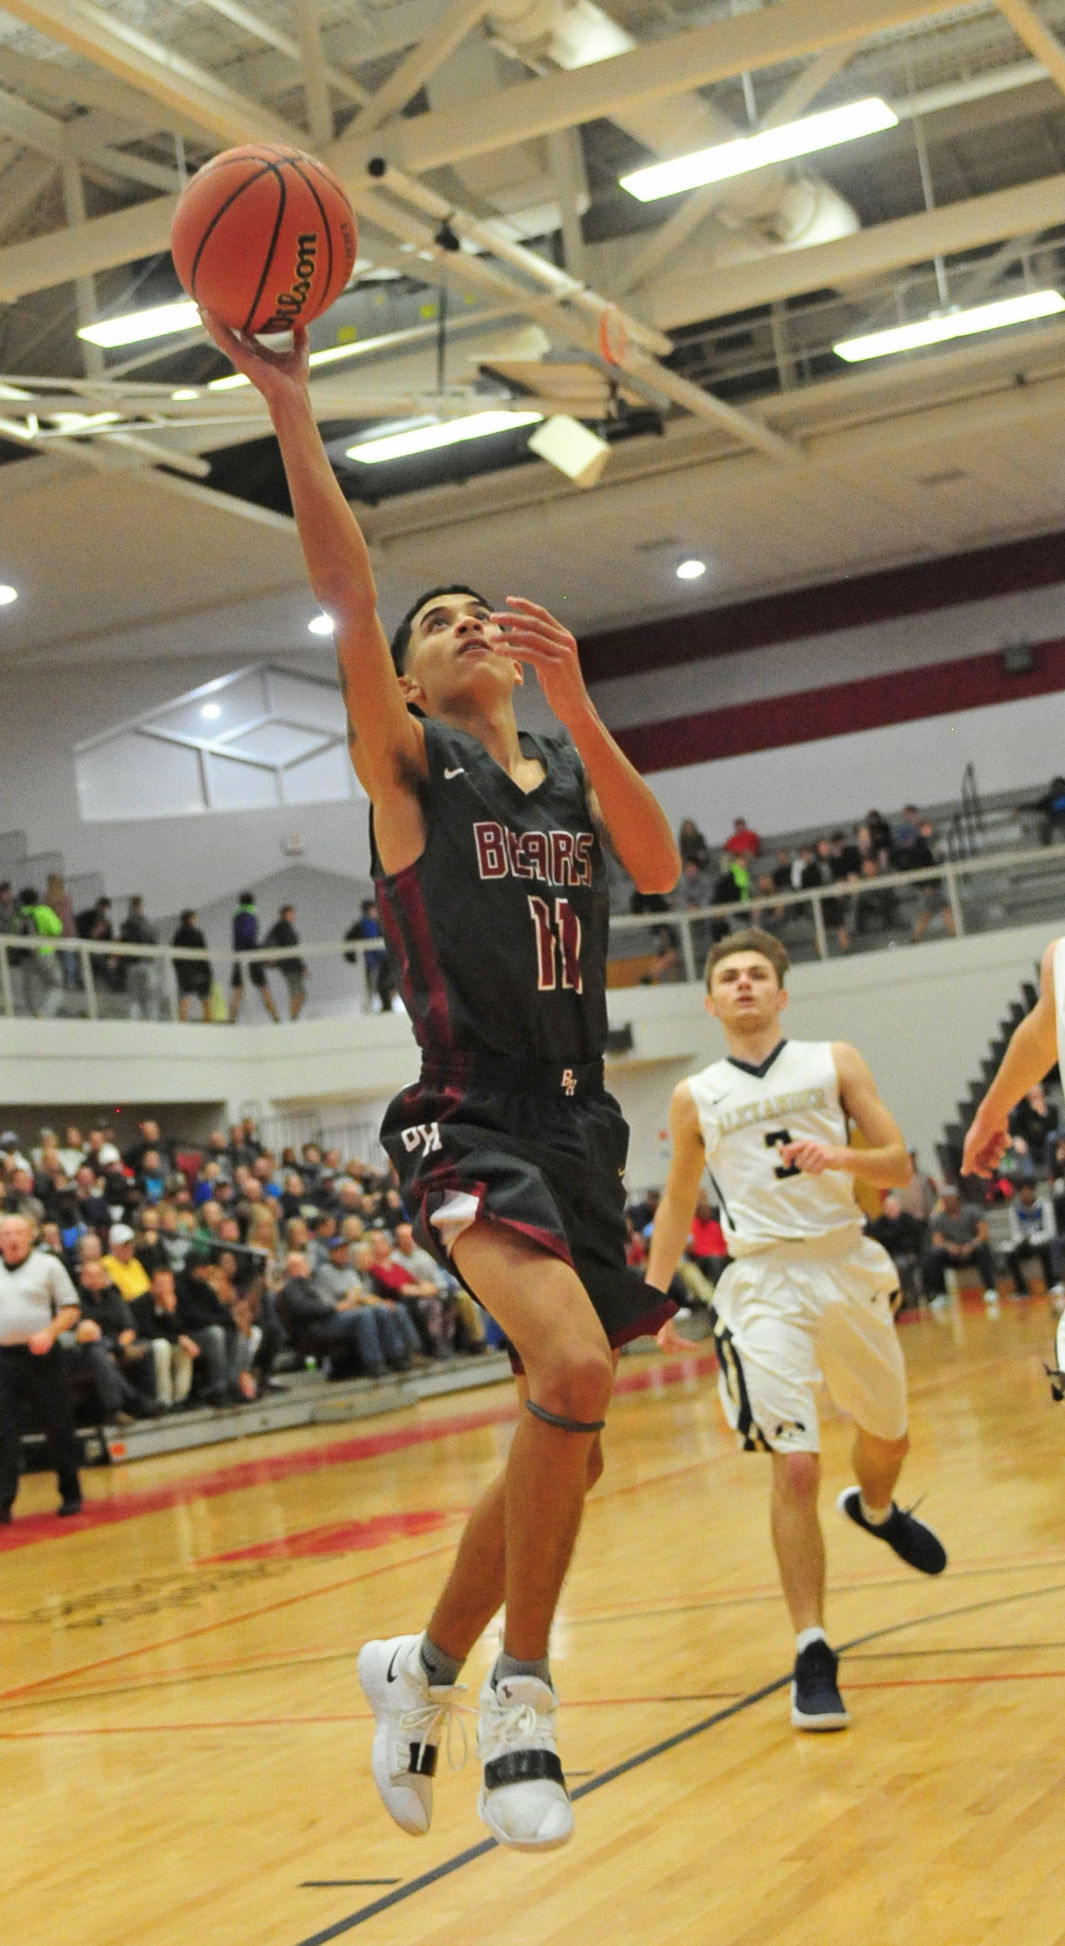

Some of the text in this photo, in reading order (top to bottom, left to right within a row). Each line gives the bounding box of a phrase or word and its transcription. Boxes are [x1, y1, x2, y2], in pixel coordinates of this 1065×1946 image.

[473, 821, 594, 887] BEARS
[527, 895, 584, 994] 11
[718, 1087, 828, 1136] ALEXANDER
